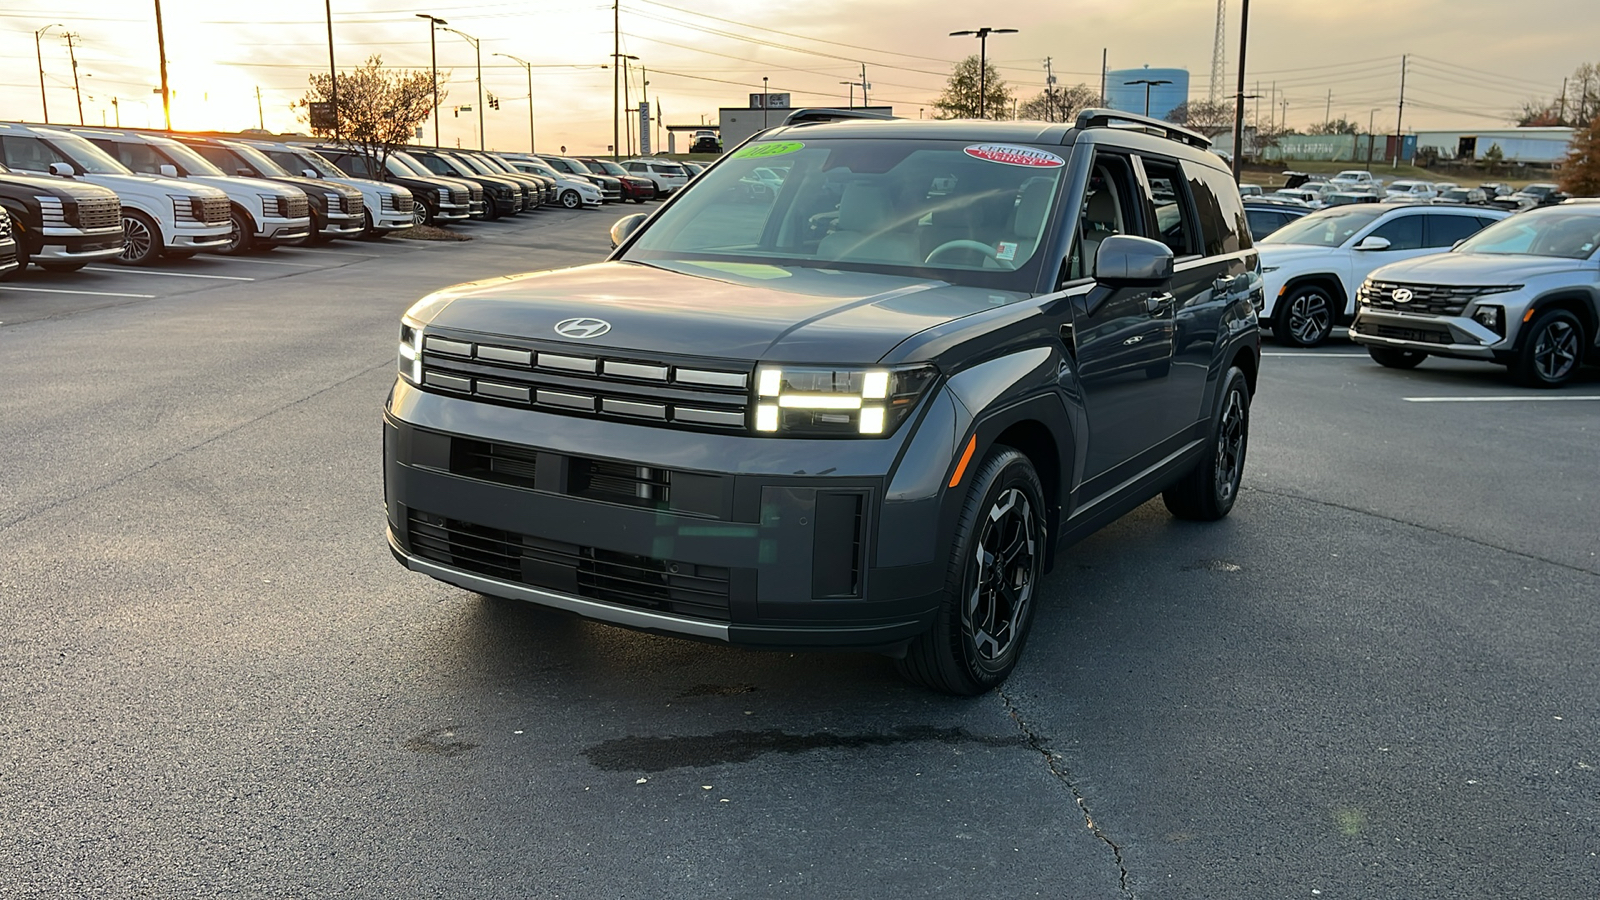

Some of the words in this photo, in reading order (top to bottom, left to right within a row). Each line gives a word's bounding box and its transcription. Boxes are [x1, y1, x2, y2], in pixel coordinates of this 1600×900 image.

[739, 143, 797, 158] 2025
[977, 144, 1055, 161] CERTIFIED
[1303, 143, 1334, 154] SHIPPING
